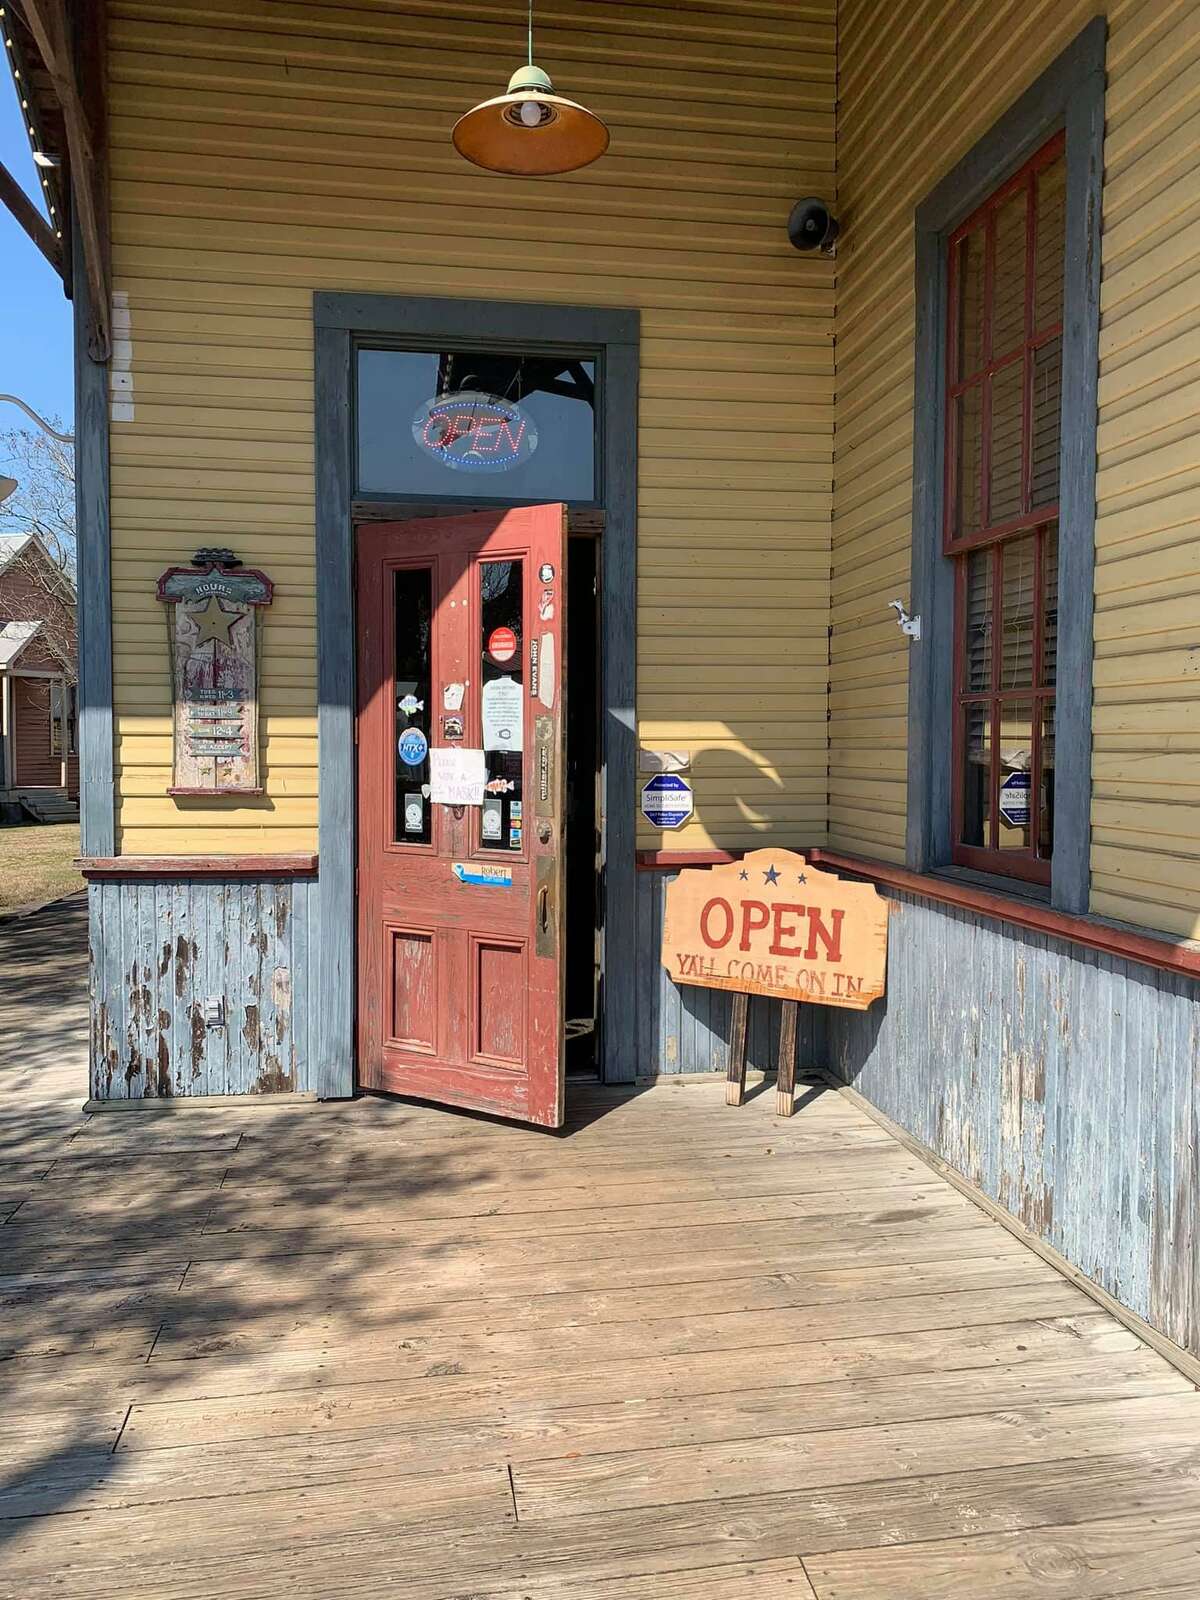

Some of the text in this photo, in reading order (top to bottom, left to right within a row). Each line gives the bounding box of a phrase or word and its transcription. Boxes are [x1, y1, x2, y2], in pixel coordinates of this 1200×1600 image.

[424, 414, 526, 452] OPEN
[195, 583, 232, 594] HOURS
[646, 793, 686, 802] SimpliSafe
[700, 897, 845, 962] OPEN
[728, 960, 788, 988] COME
[797, 968, 827, 995] ON
[831, 973, 864, 998] IN
